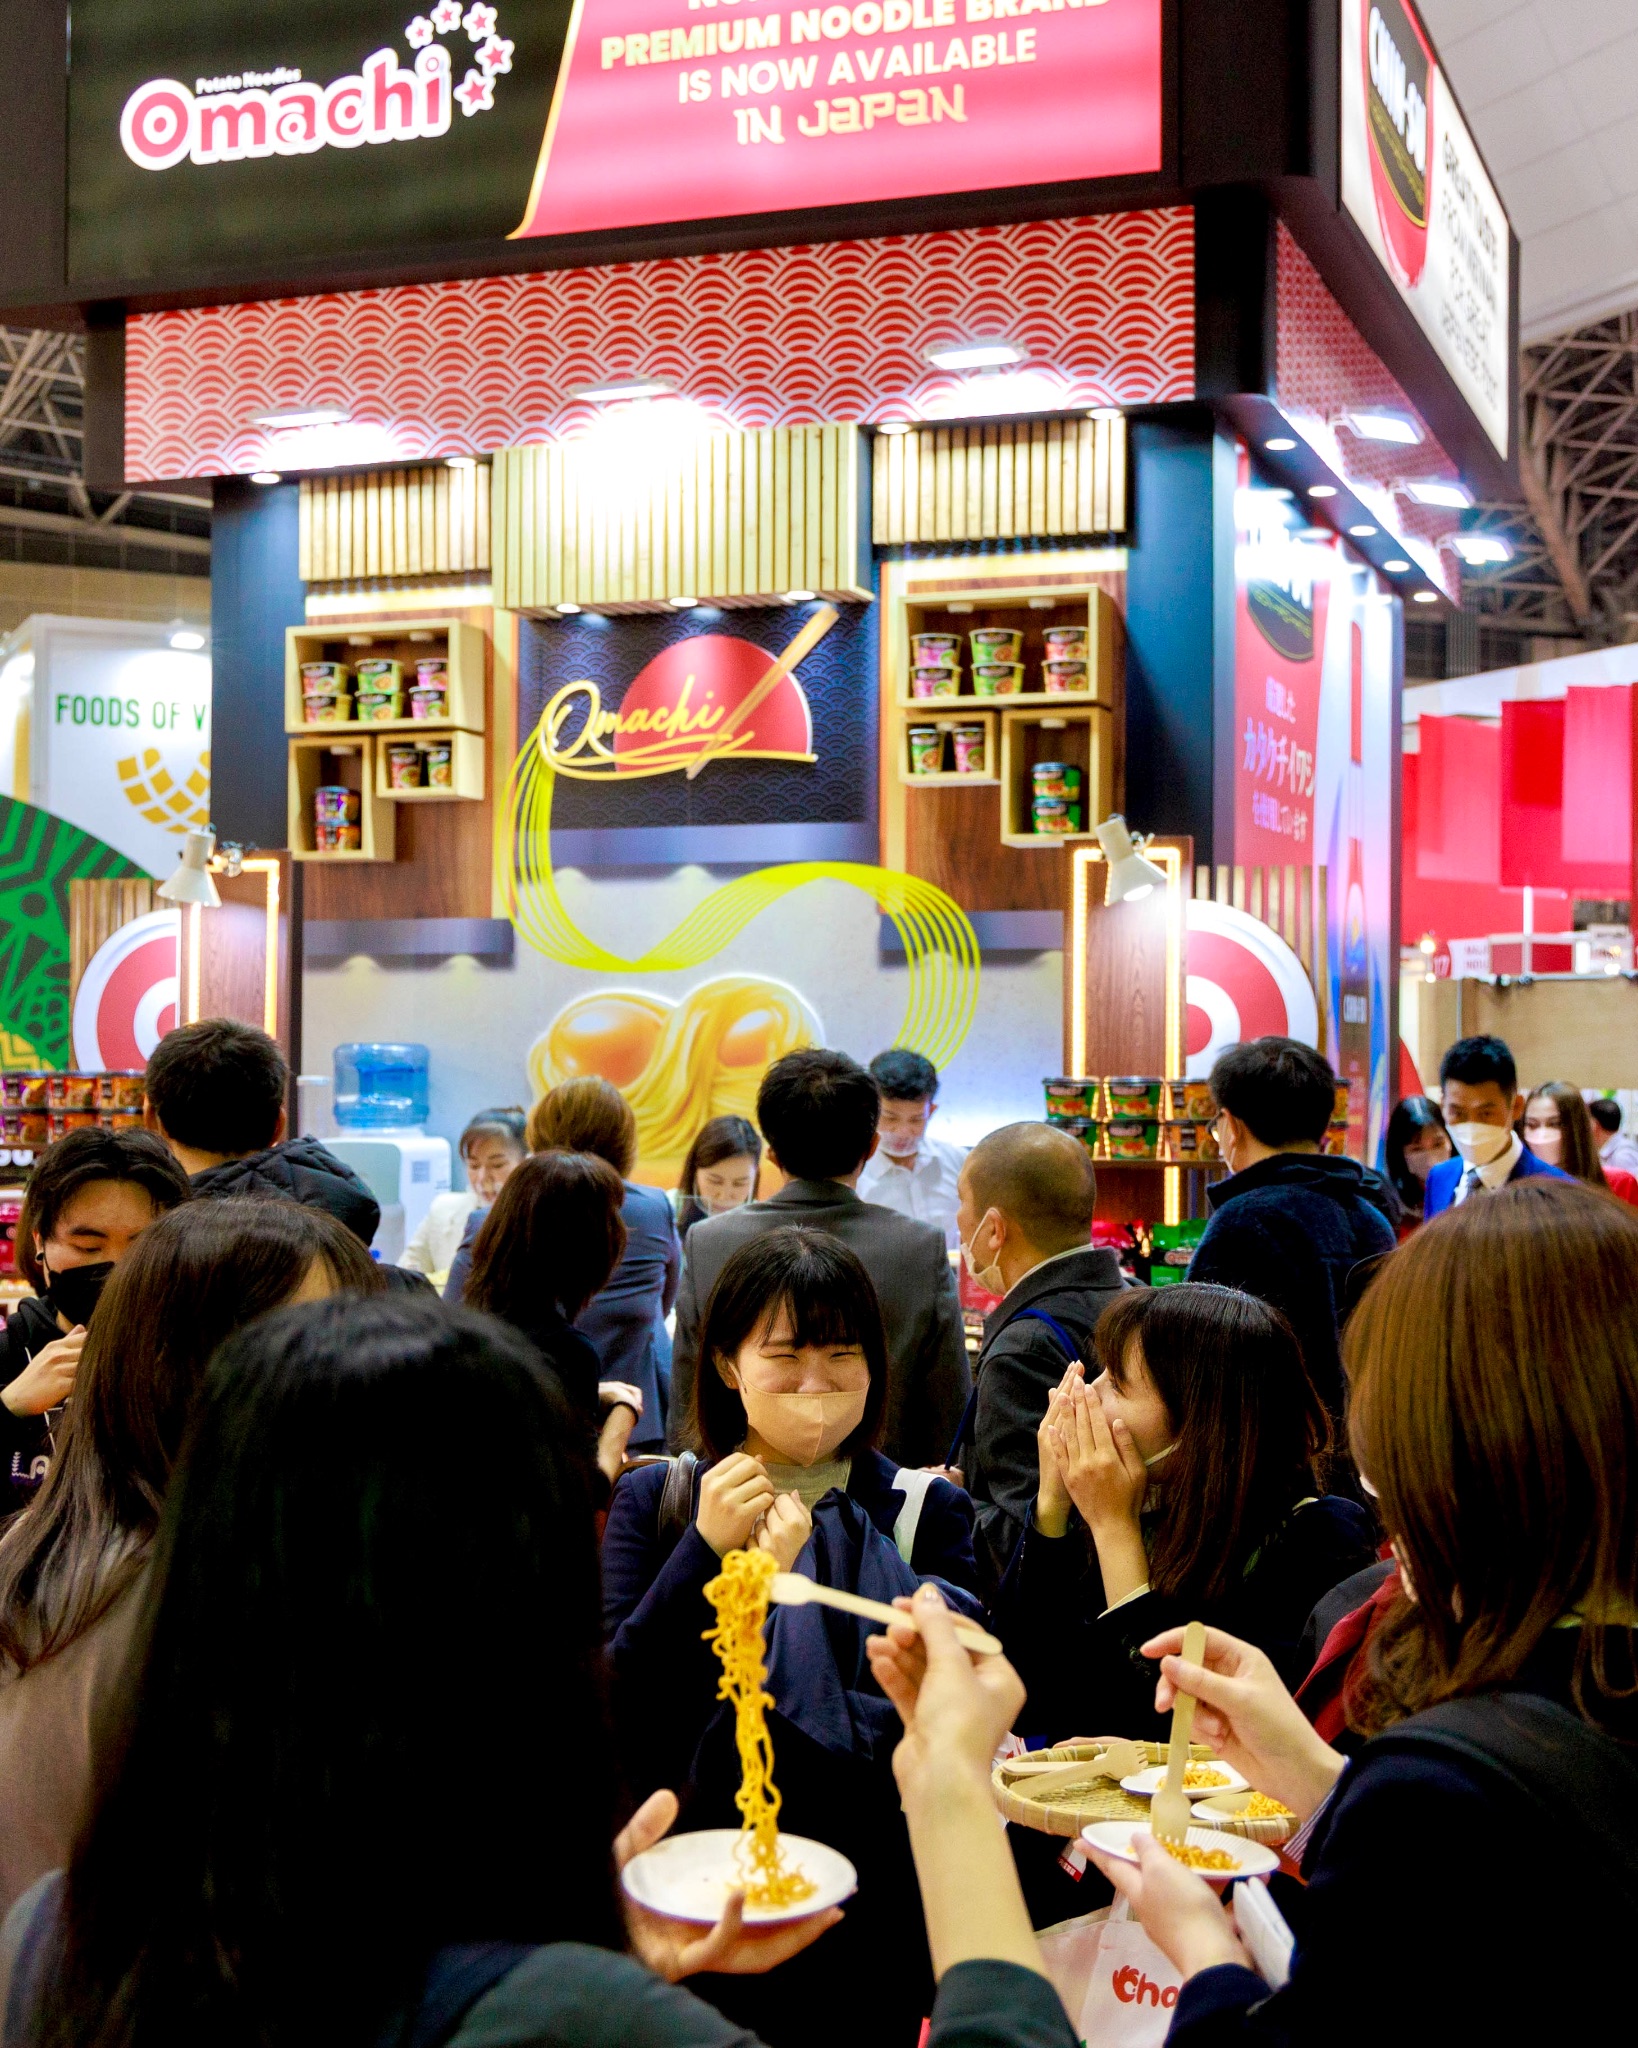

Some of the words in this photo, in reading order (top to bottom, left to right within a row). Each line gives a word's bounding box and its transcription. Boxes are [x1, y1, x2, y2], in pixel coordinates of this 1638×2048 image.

[601, 14, 781, 69] PREMIUM
[791, 0, 956, 44] NOODLE
[679, 69, 712, 103] IS
[720, 55, 818, 98] NOW
[827, 28, 1037, 86] AVAILABLE
[125, 47, 447, 166] Omachi
[733, 105, 785, 145] IN
[56, 694, 140, 729] FOODS
[152, 702, 181, 729] OF
[538, 674, 727, 760] Omachi
